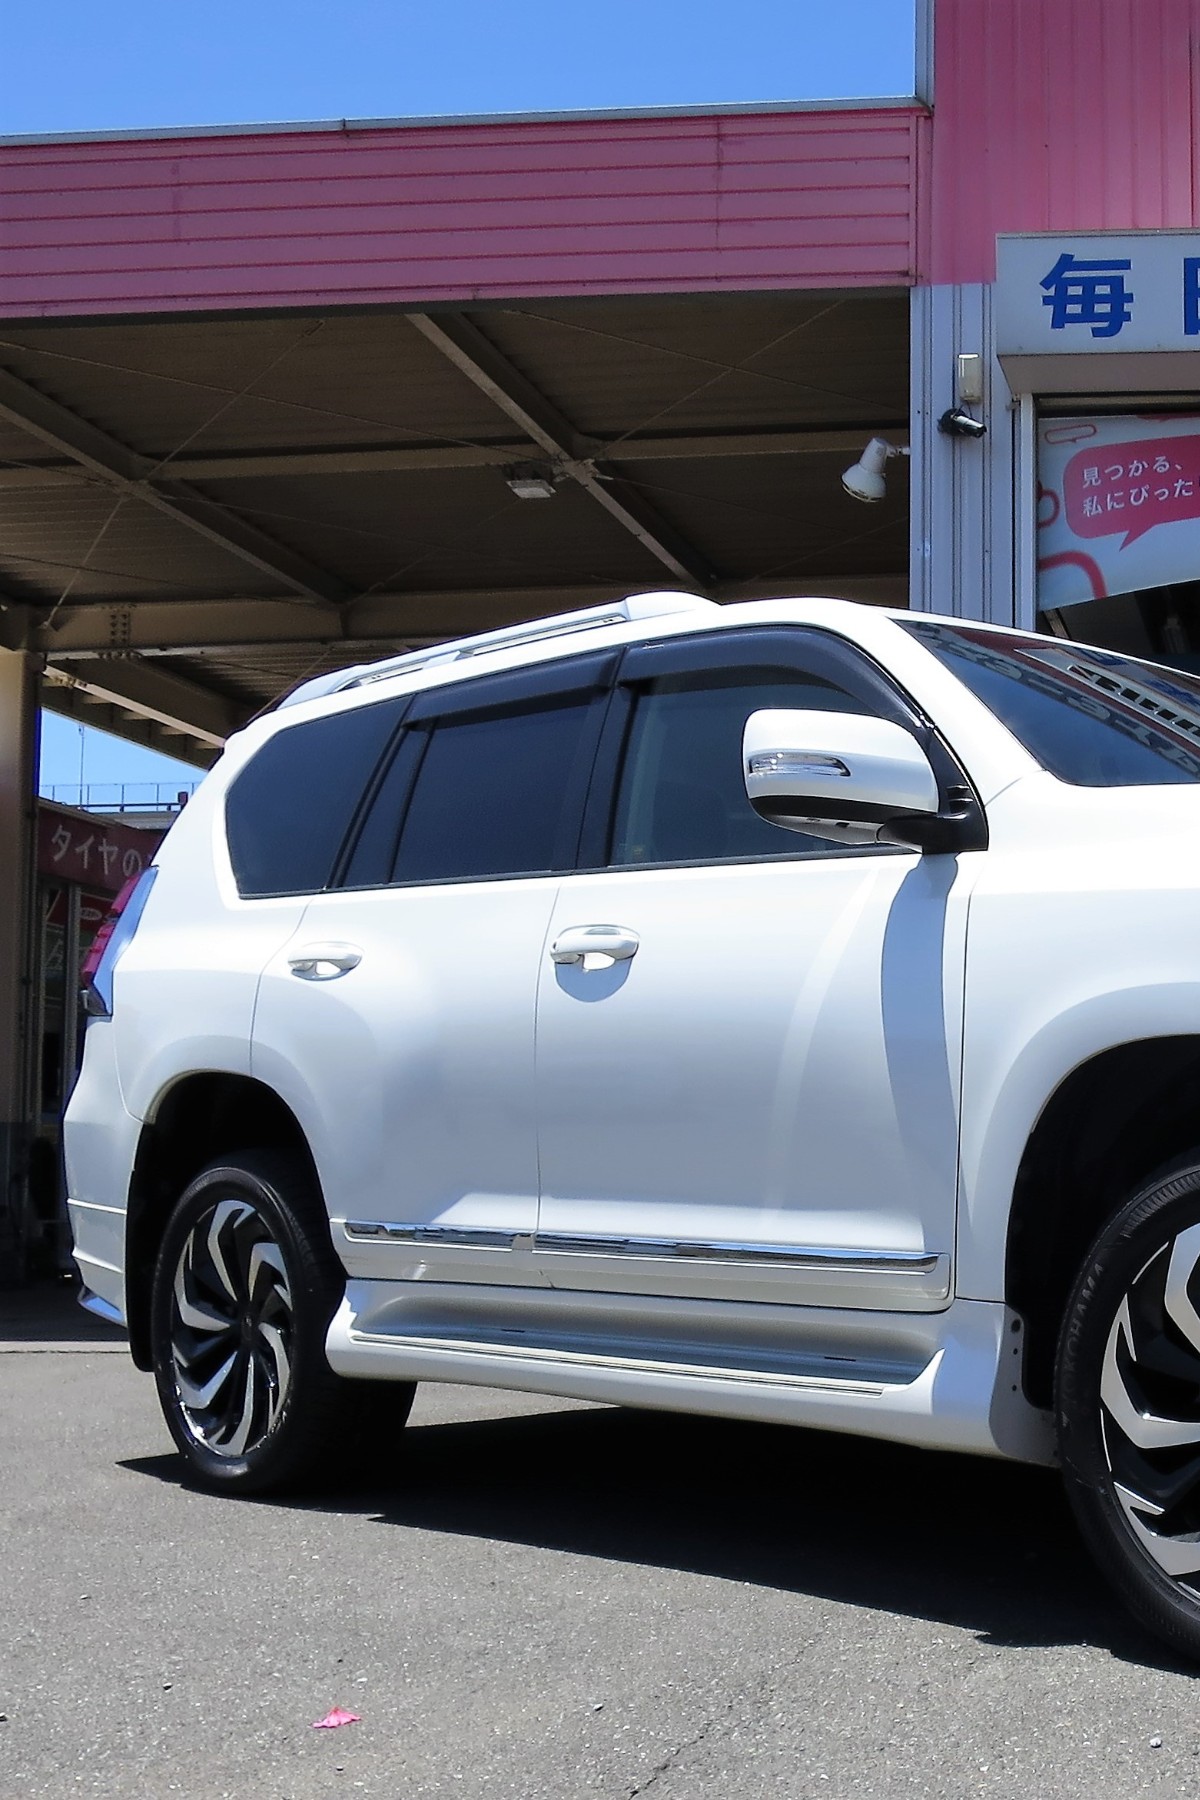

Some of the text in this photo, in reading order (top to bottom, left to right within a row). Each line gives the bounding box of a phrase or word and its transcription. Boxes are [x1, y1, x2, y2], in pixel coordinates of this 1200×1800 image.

[1081, 455, 1185, 489] 見つかる、
[51, 824, 146, 876] タイヤの
